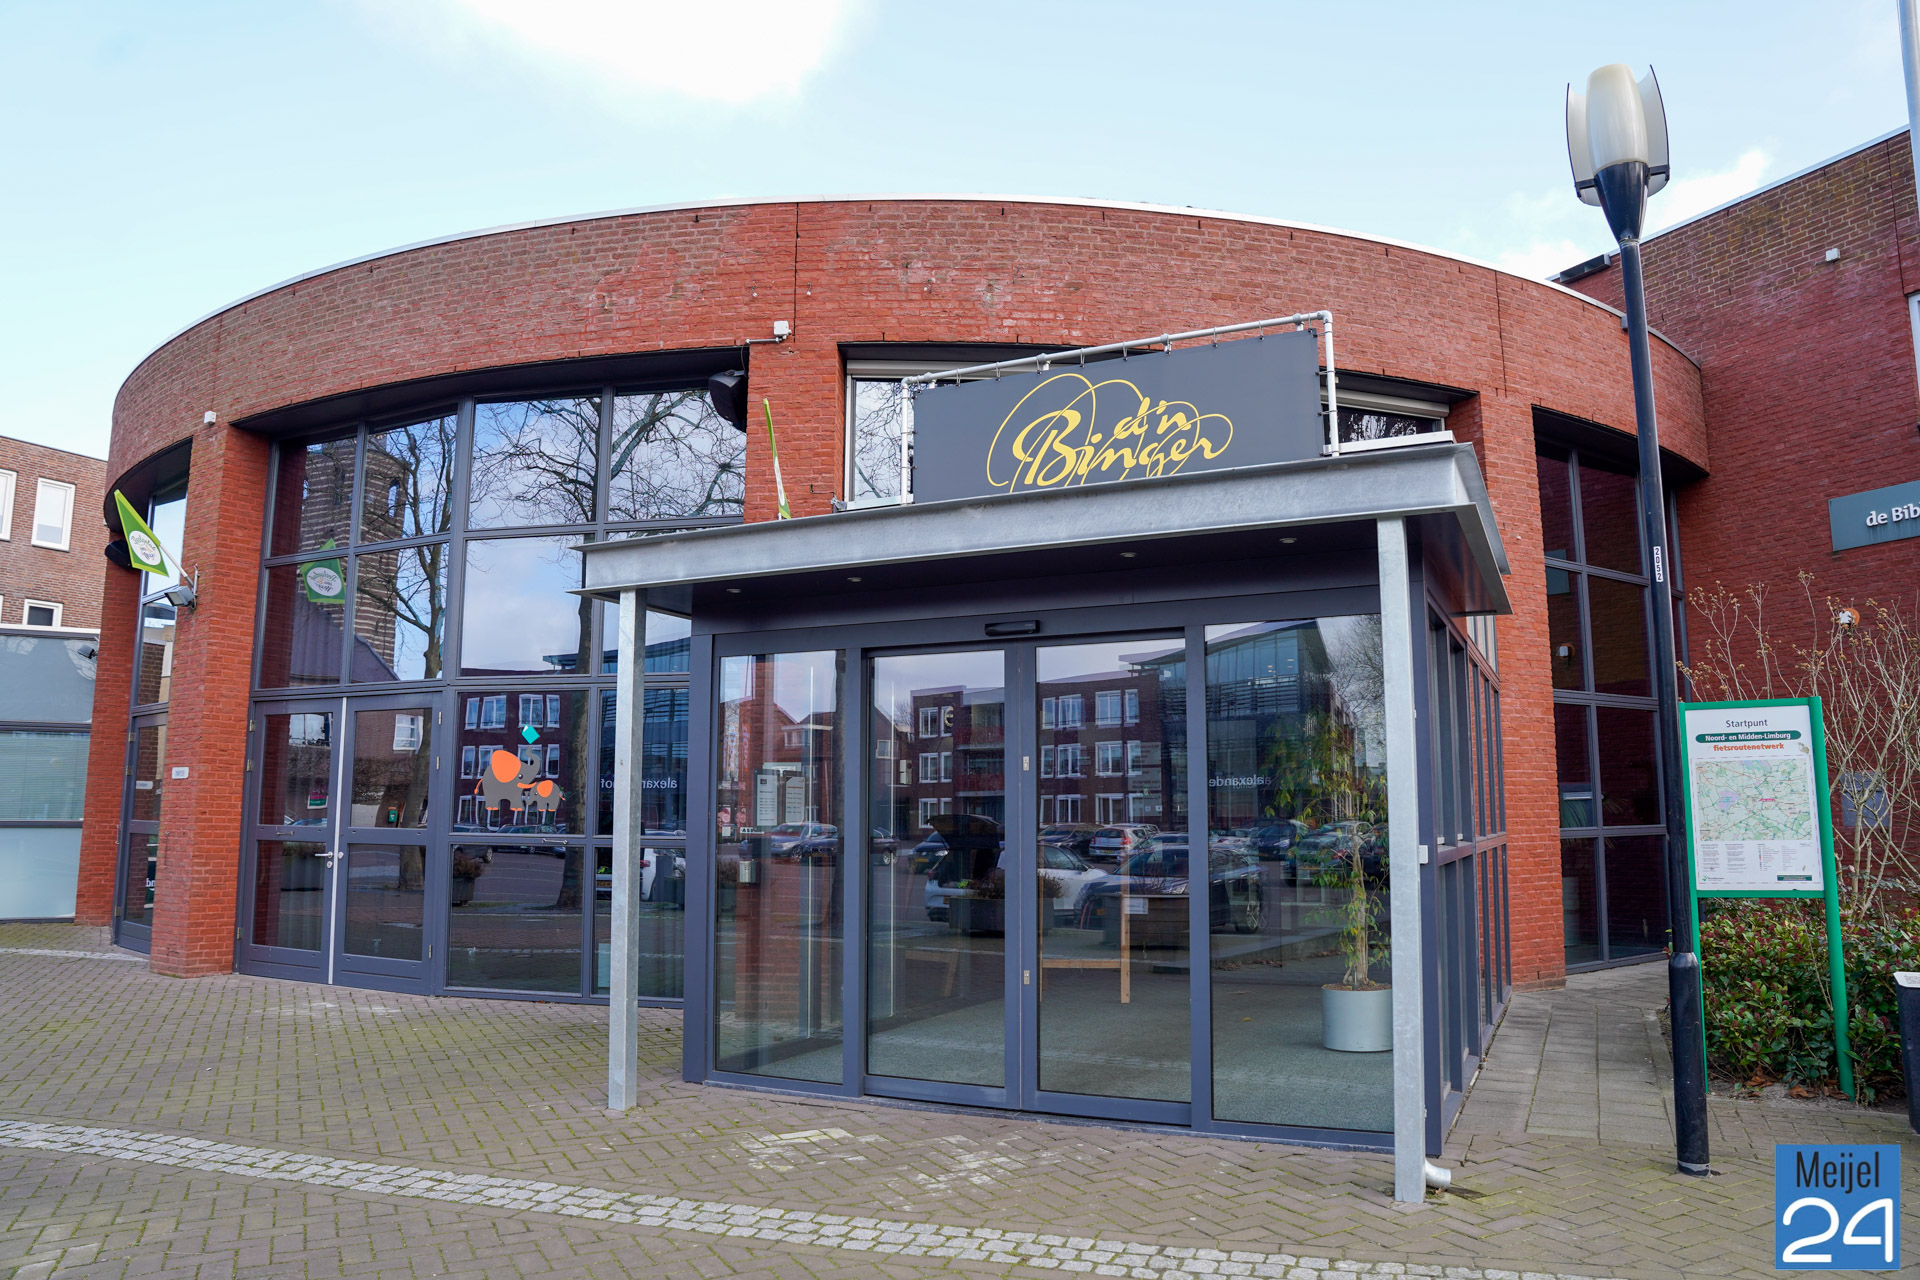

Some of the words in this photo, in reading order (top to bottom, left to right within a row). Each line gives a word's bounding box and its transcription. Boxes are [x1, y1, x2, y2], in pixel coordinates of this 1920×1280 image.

[1114, 397, 1191, 439] d'n
[1002, 402, 1233, 490] Binger
[1866, 510, 1888, 527] de
[1891, 501, 1920, 522] Bib
[1725, 719, 1768, 728] Startpunt
[1705, 734, 1727, 742] Noord-
[1738, 732, 1791, 741] Midden-Limburg
[1713, 742, 1784, 752] fietsroutenetwerk
